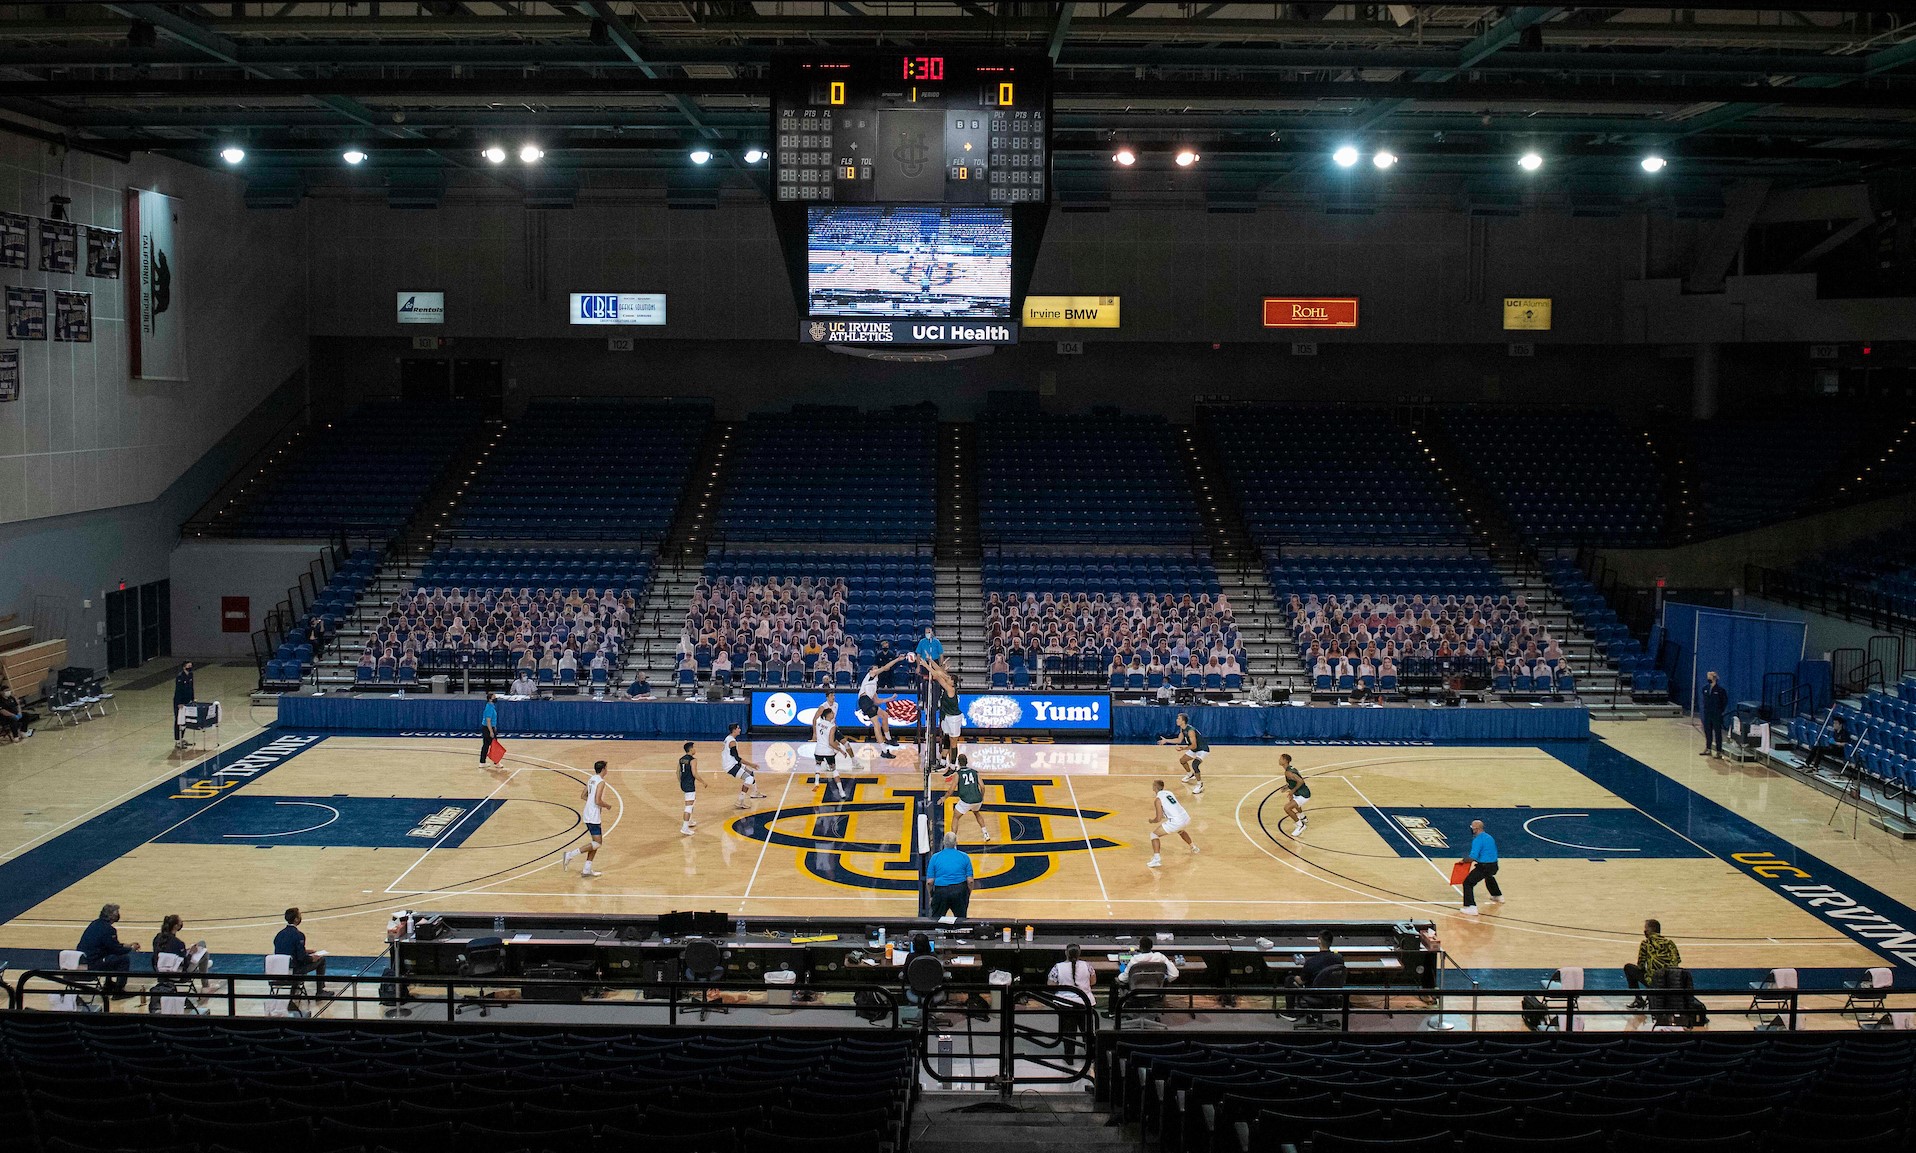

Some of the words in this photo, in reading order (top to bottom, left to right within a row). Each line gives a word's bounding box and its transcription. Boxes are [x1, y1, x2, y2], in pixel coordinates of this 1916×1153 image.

[903, 56, 944, 80] 1:30
[830, 81, 845, 105] 0
[999, 82, 1014, 106] 0
[783, 109, 795, 117] PLY
[804, 109, 816, 117] PTS
[823, 109, 831, 117] FL
[993, 111, 1006, 119] PLY
[1014, 111, 1027, 119] PTS
[1033, 111, 1042, 119] FL
[840, 157, 853, 165] FLS
[861, 157, 873, 165] TOL
[953, 158, 965, 166] FLS
[973, 158, 985, 166] TOL
[581, 296, 618, 318] CBE
[635, 303, 656, 311] SOLUTIONS
[1030, 308, 1061, 318] Irvine
[1065, 309, 1098, 320] BMW
[829, 323, 846, 333] UC
[849, 323, 891, 333] IRVINE
[912, 326, 945, 340] UCI
[951, 325, 1010, 341] Health
[829, 332, 893, 342] ATHLETICS
[419, 338, 431, 348] 101
[613, 340, 628, 350] 102
[1061, 343, 1077, 353] 104
[1297, 344, 1312, 354] 105
[972, 697, 1019, 708] NEWPORT
[983, 705, 1007, 716] RIB
[1030, 701, 1100, 721] Yum!
[972, 713, 1017, 725] COMPANY
[399, 731, 624, 740] UCIRVINSPORTS.COM
[211, 735, 320, 777] IRVINE
[962, 772, 975, 785] 24
[168, 780, 239, 800] UC
[1731, 852, 1812, 879] UC
